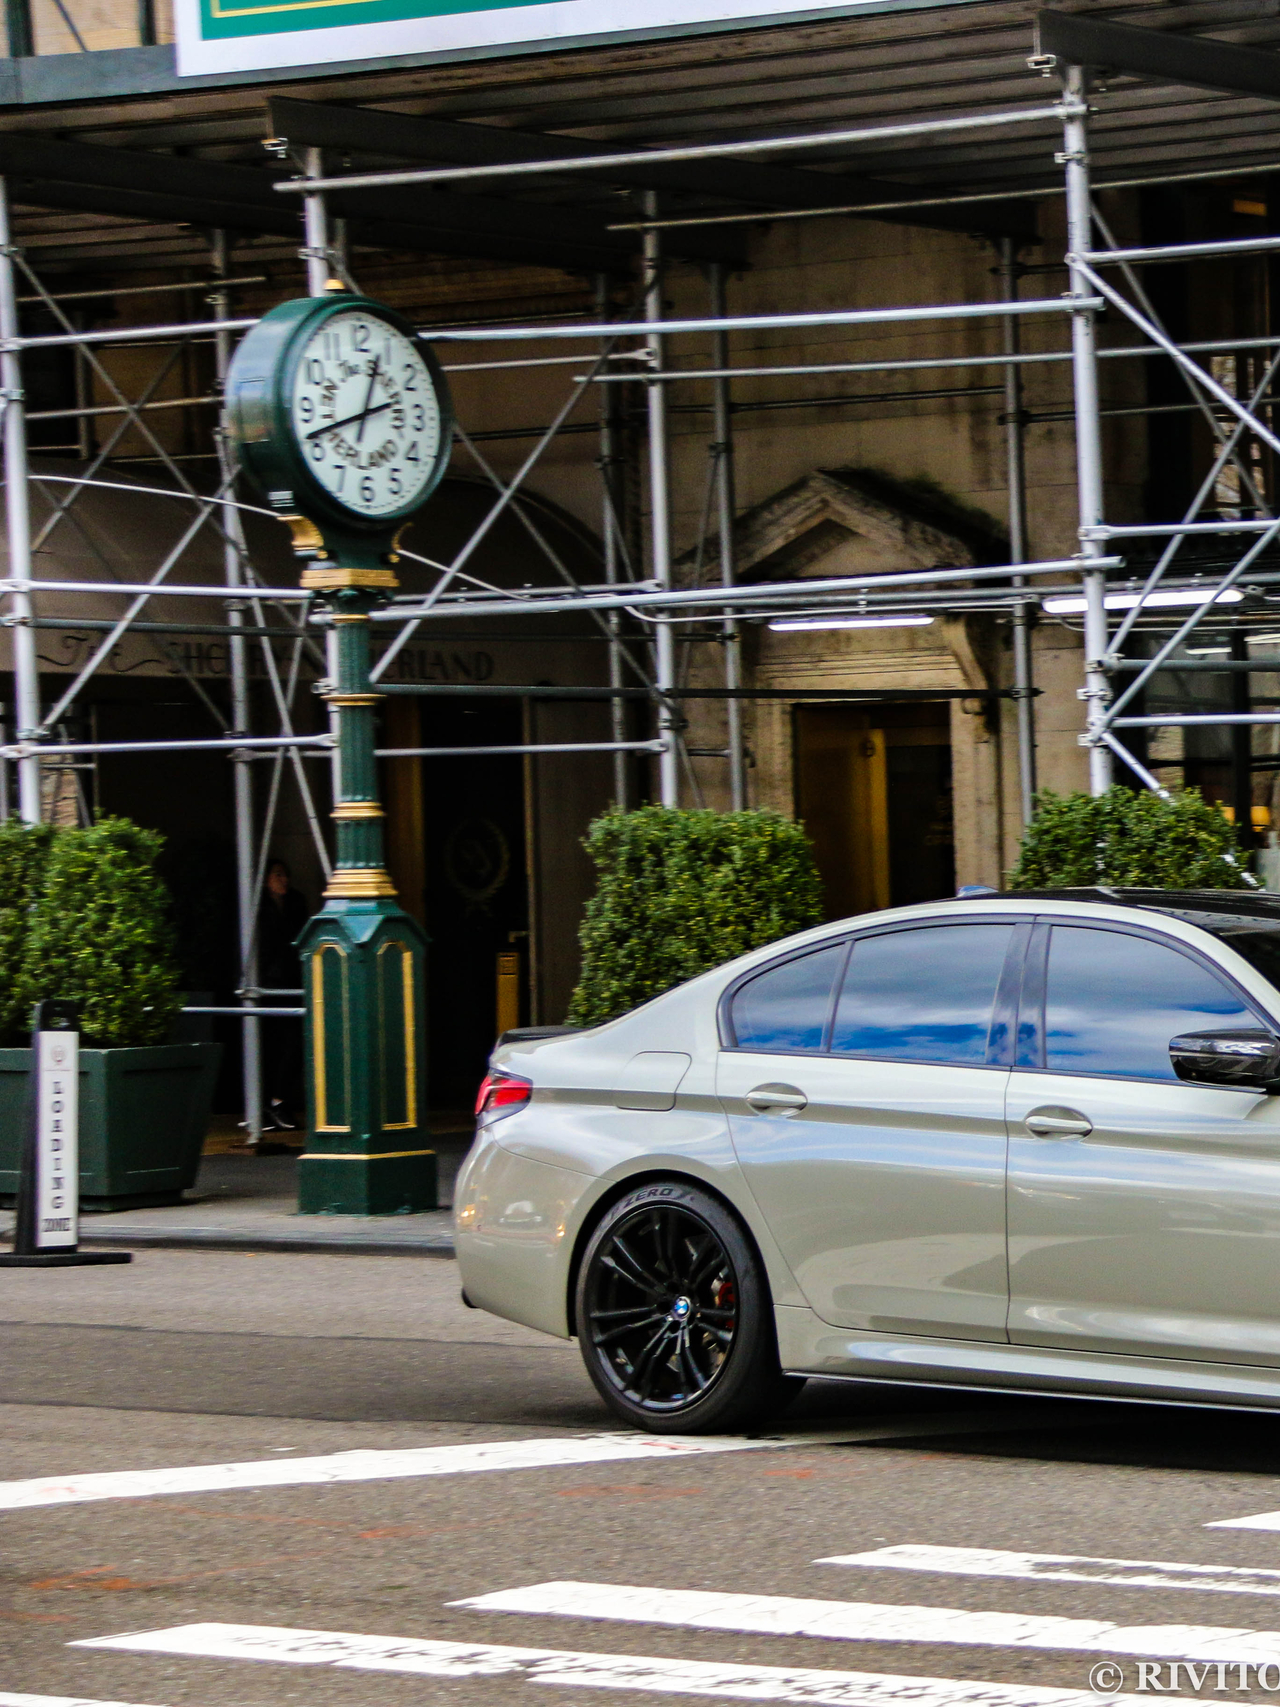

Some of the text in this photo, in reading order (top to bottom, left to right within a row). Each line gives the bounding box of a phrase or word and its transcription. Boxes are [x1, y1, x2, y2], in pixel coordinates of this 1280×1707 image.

[323, 332, 342, 362] 11
[351, 323, 371, 353] 12
[384, 337, 392, 366] 1
[304, 358, 325, 386] 10
[403, 363, 417, 392] 2
[300, 396, 314, 424] 9
[412, 403, 426, 432] 3
[405, 440, 421, 463] 4
[332, 464, 347, 493] 7
[360, 475, 375, 503] 6
[387, 467, 402, 495] 5
[50, 1081, 66, 1210] LOADING
[623, 1187, 674, 1208] ZERO
[41, 1217, 73, 1233] ZONE
